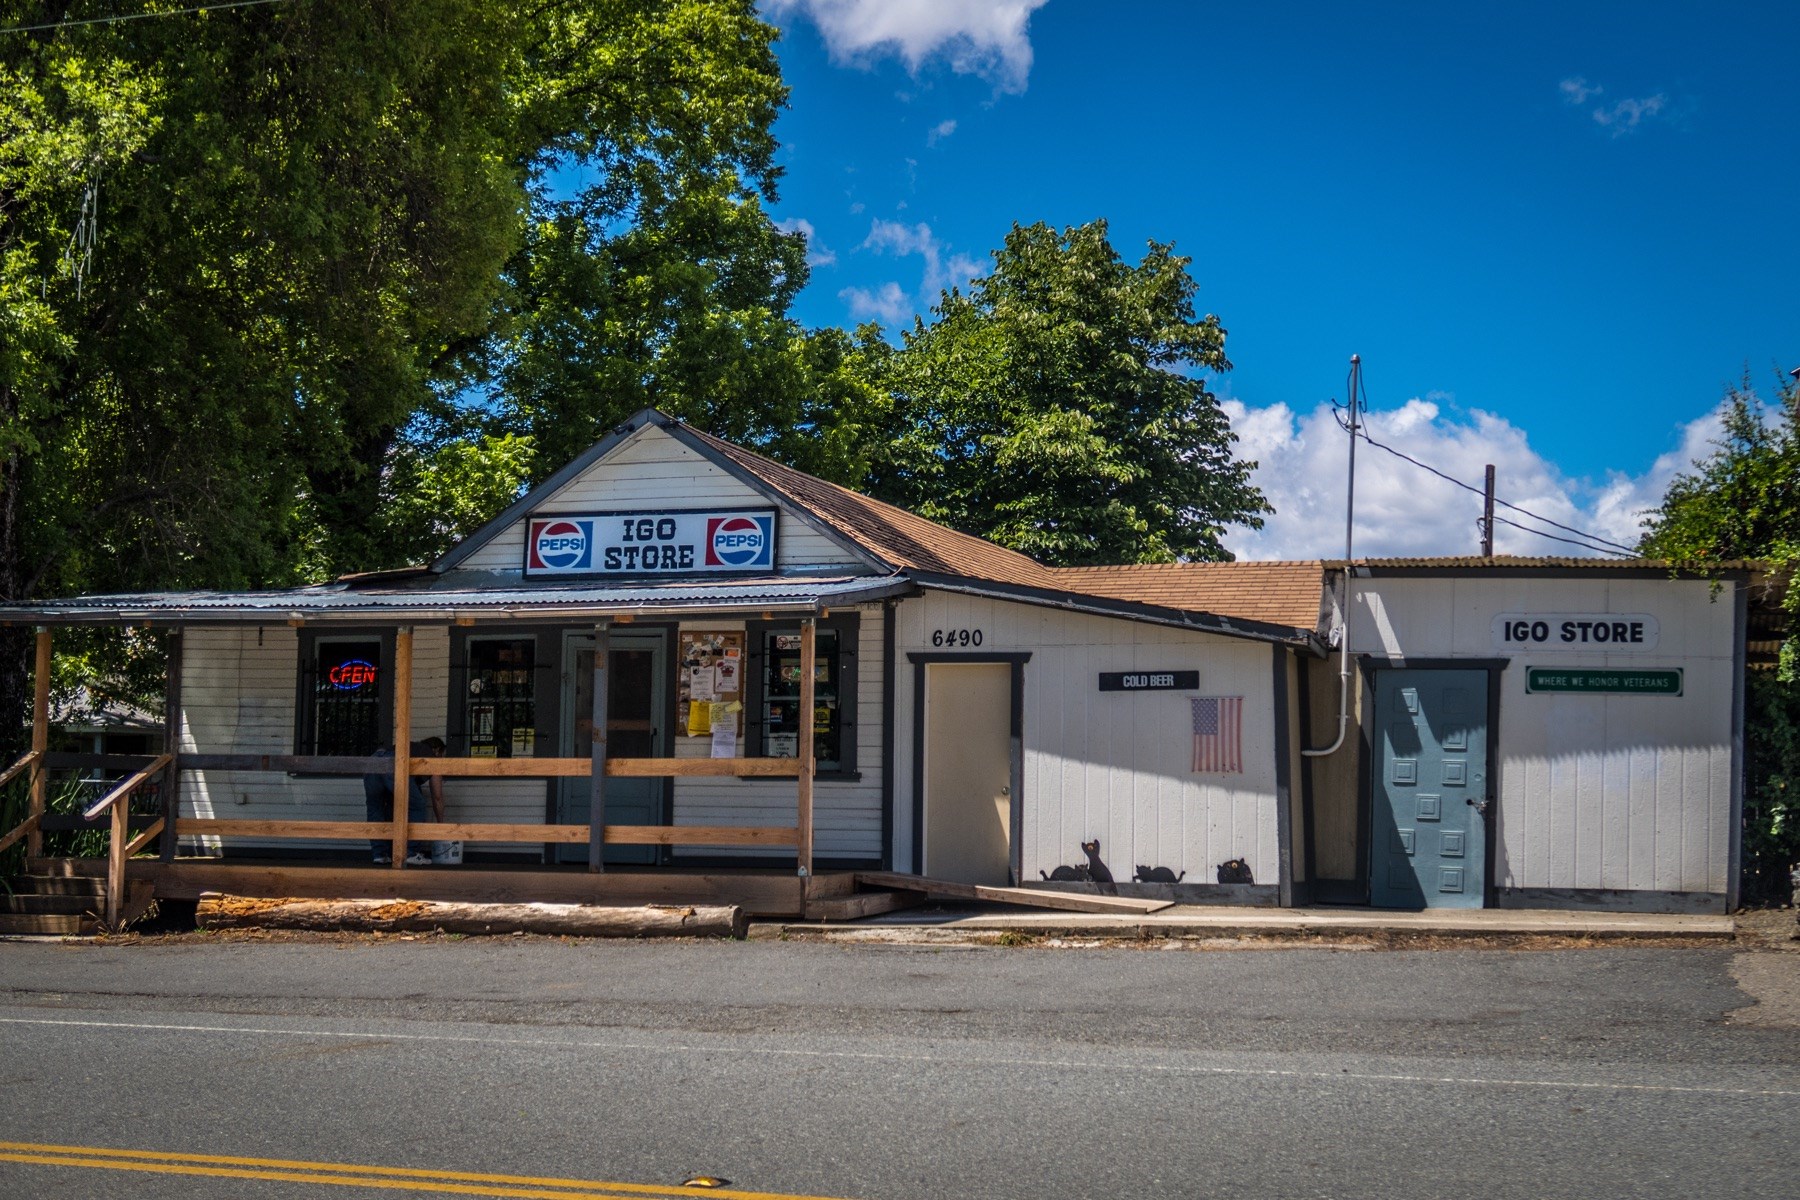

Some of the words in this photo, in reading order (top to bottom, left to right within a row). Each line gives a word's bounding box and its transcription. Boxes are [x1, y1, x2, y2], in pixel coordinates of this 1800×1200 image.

[622, 518, 677, 542] IGO
[538, 537, 585, 551] PEPSI
[714, 533, 762, 548] PEPSI
[604, 544, 695, 570] STORE
[932, 629, 984, 647] 6490
[1504, 621, 1550, 642] IGO
[1560, 621, 1644, 643] STORE
[1123, 674, 1148, 688] COLD
[1149, 673, 1175, 687] BEER
[1537, 676, 1567, 686] WHERE
[1571, 677, 1584, 686] WE
[1588, 677, 1619, 687] HONOR
[1623, 677, 1669, 688] VETERANS
